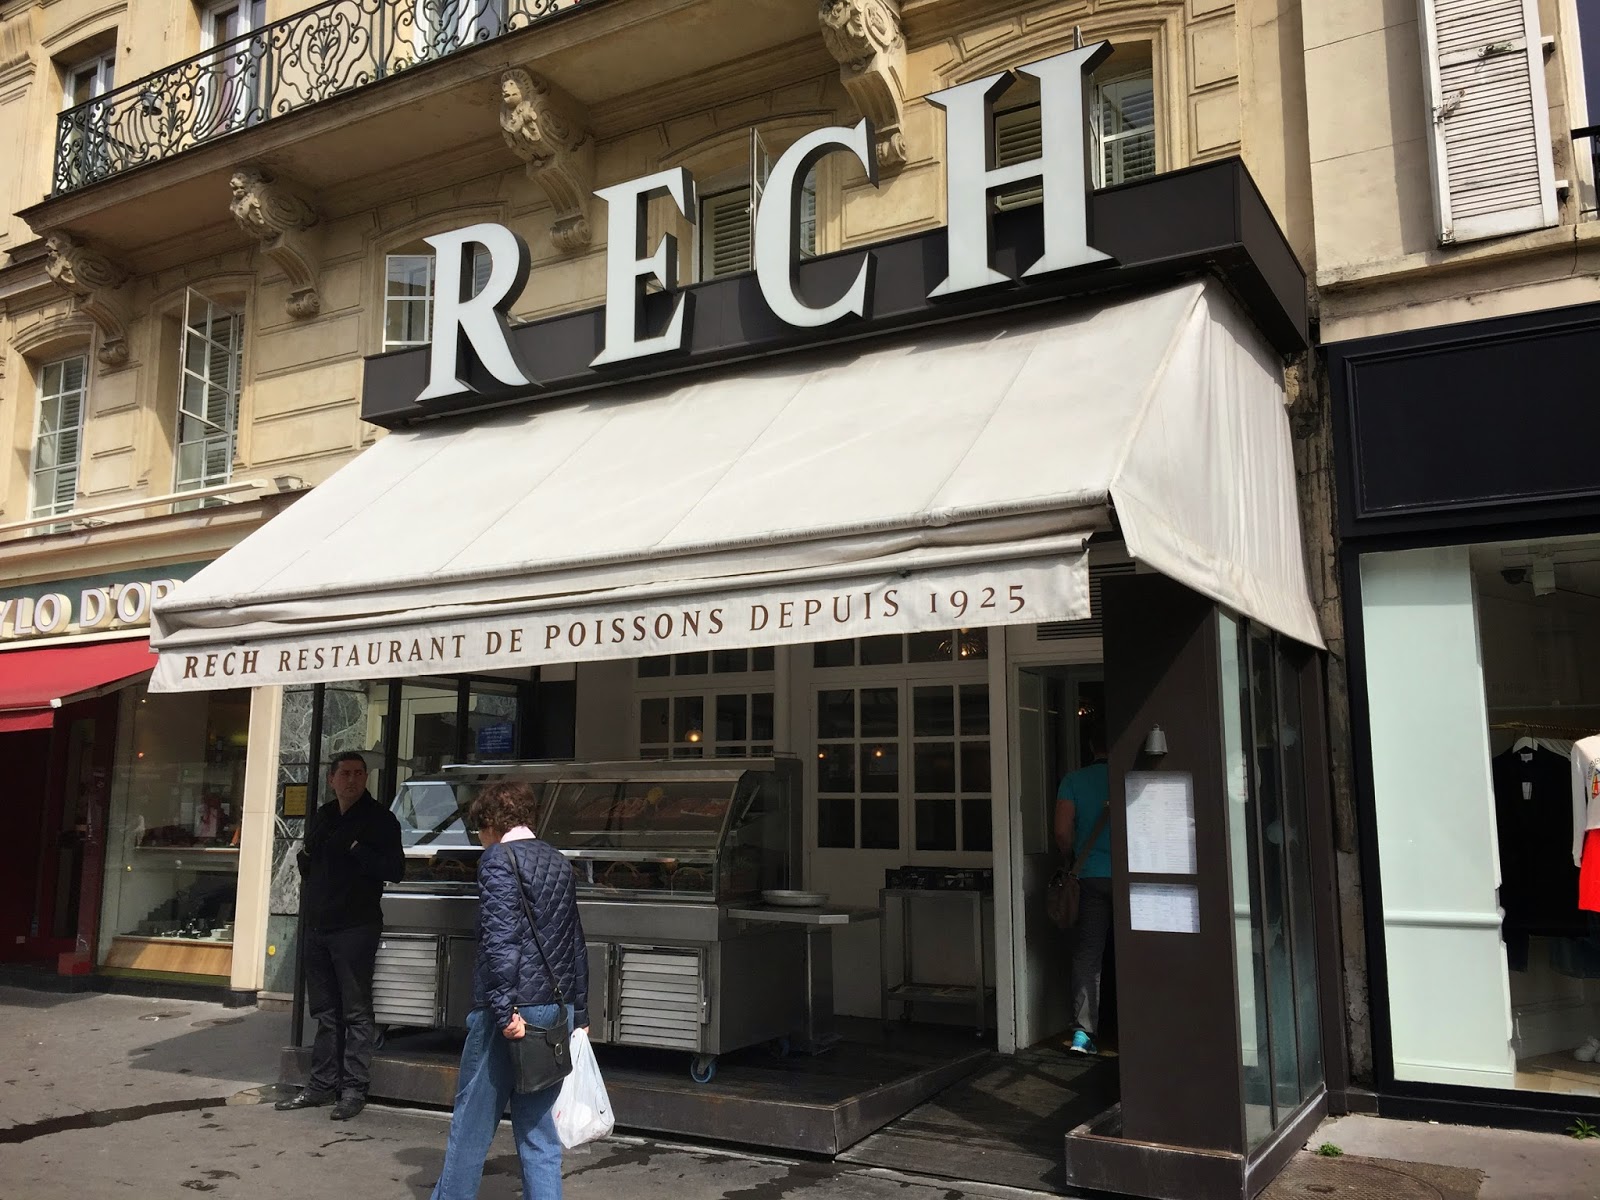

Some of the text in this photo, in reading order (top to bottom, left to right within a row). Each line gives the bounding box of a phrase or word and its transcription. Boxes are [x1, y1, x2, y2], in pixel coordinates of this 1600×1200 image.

[415, 41, 1113, 401] RECH
[184, 585, 1026, 679] RECH RESTAURANT DE POISSONS DEPUIS 1925
